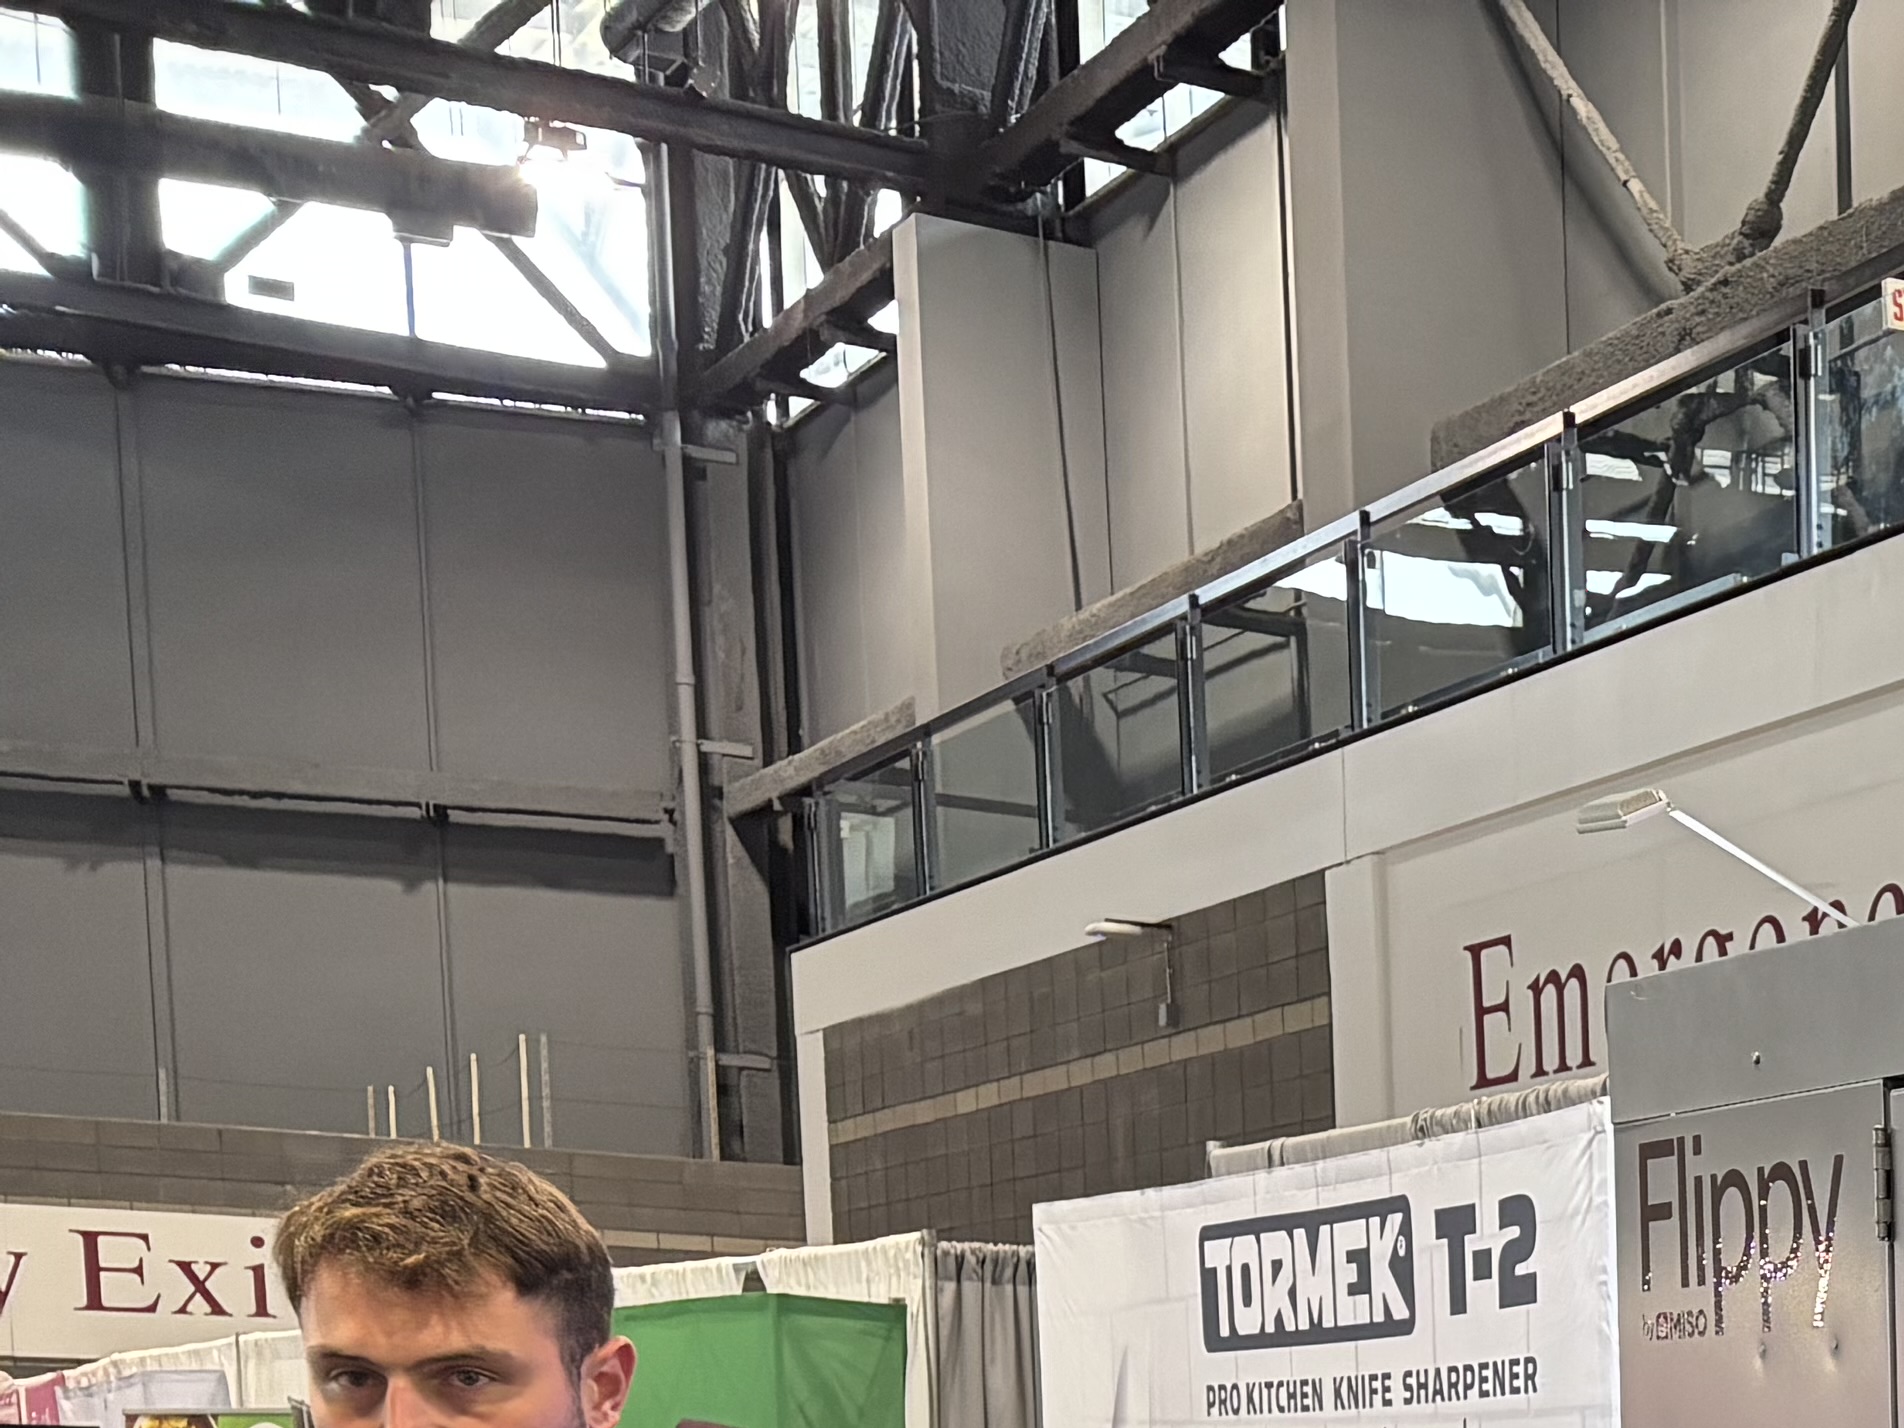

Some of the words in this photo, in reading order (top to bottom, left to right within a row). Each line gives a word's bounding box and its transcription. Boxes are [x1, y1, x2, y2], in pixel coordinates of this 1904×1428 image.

[68, 1229, 278, 1319] Exi
[1433, 1193, 1538, 1317] T-2
[1638, 1134, 1845, 1336] Flippy
[1206, 1384, 1241, 1417] PRO
[1246, 1376, 1324, 1416] KITCHEN
[1333, 1371, 1394, 1411] KNIFE
[1402, 1356, 1539, 1406] SHARPENER
